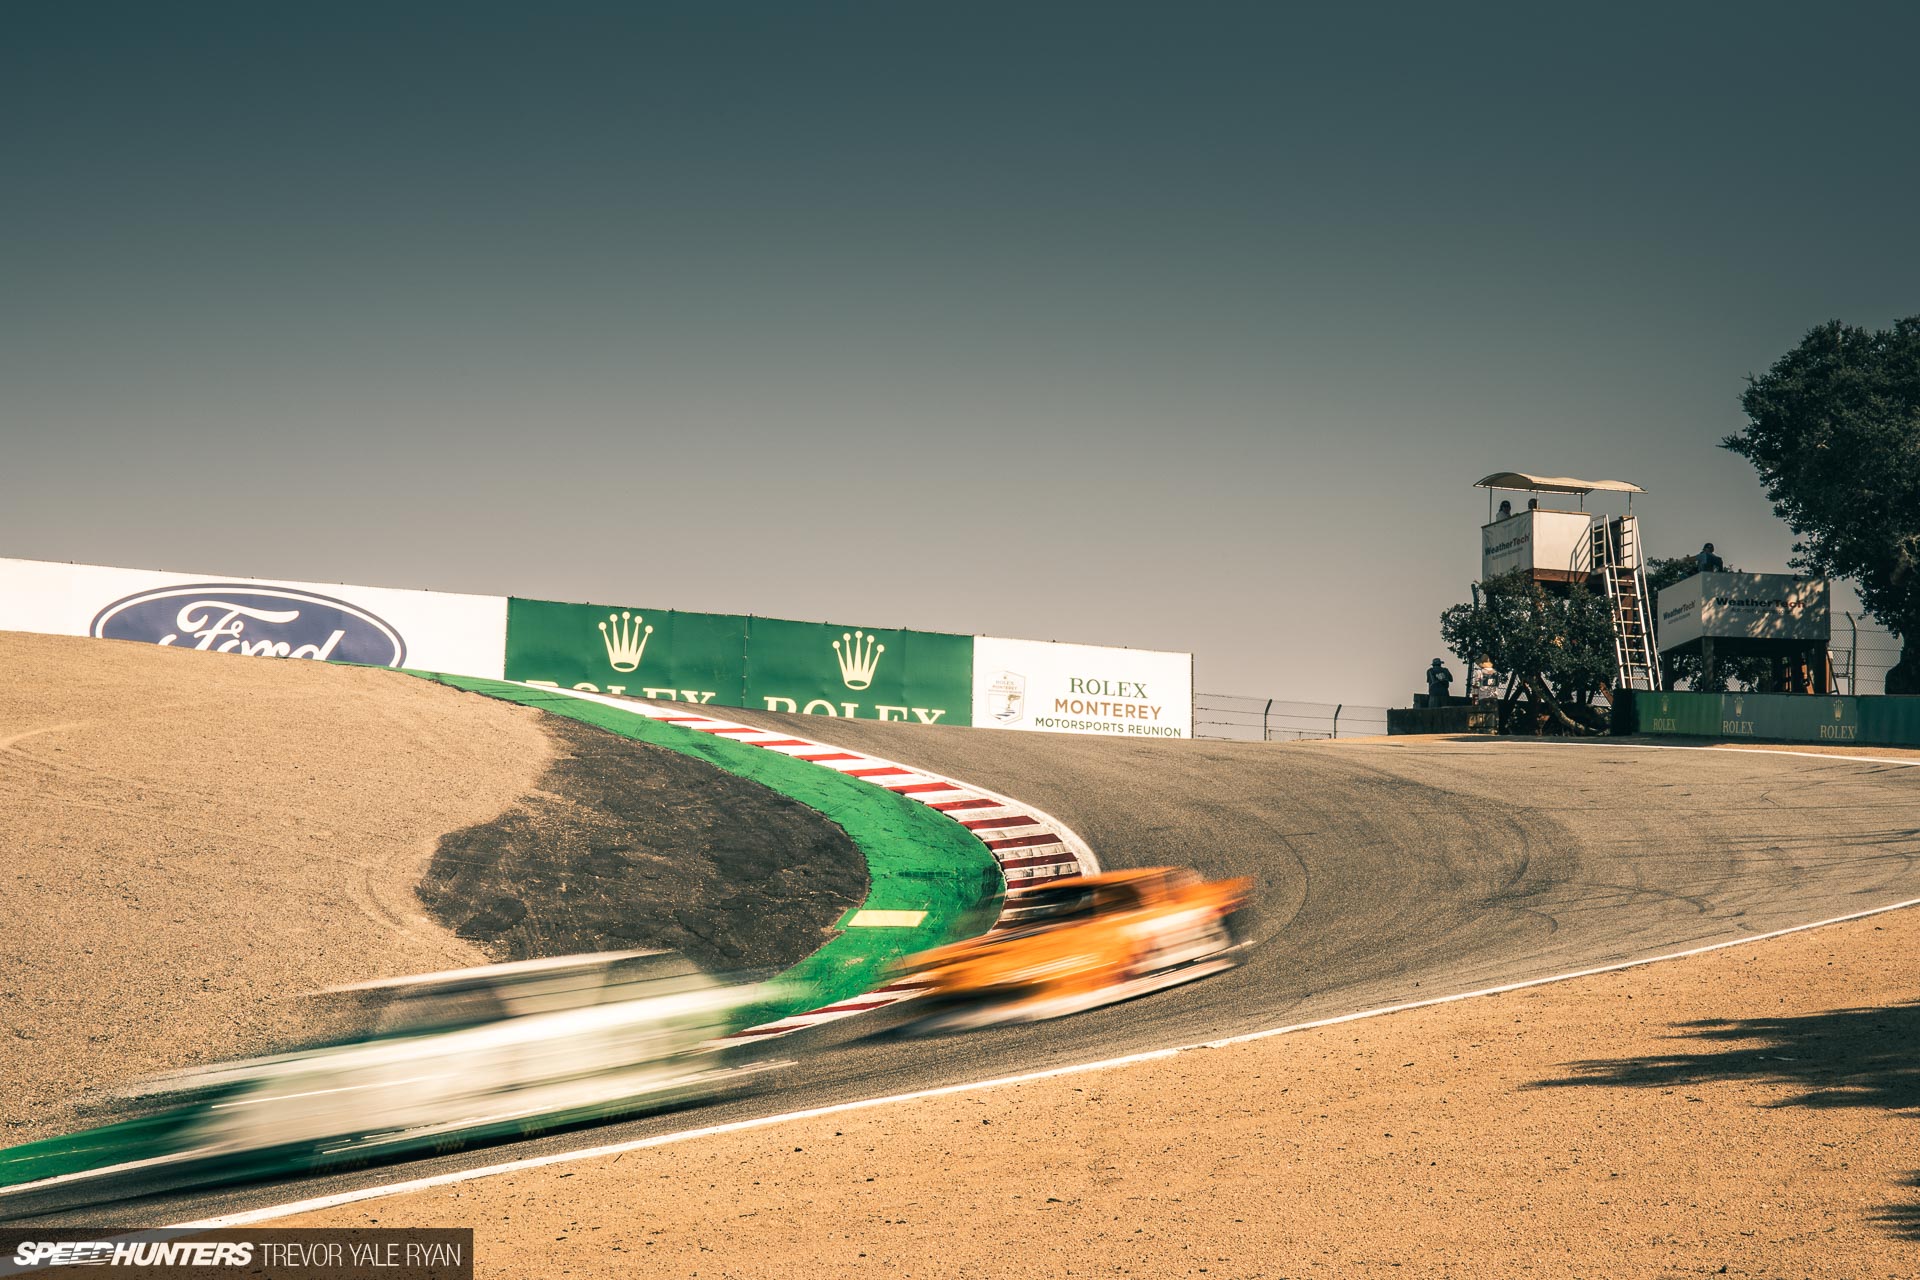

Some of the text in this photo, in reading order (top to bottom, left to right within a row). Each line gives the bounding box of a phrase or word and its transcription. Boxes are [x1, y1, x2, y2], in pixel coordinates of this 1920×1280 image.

[1069, 677, 1149, 699] ROLEX
[1055, 698, 1162, 721] MONTEREY
[1035, 717, 1182, 737] MOTORSPORTS REUNION
[1722, 720, 1754, 734] ROLEX
[1820, 725, 1855, 739] ROLEX
